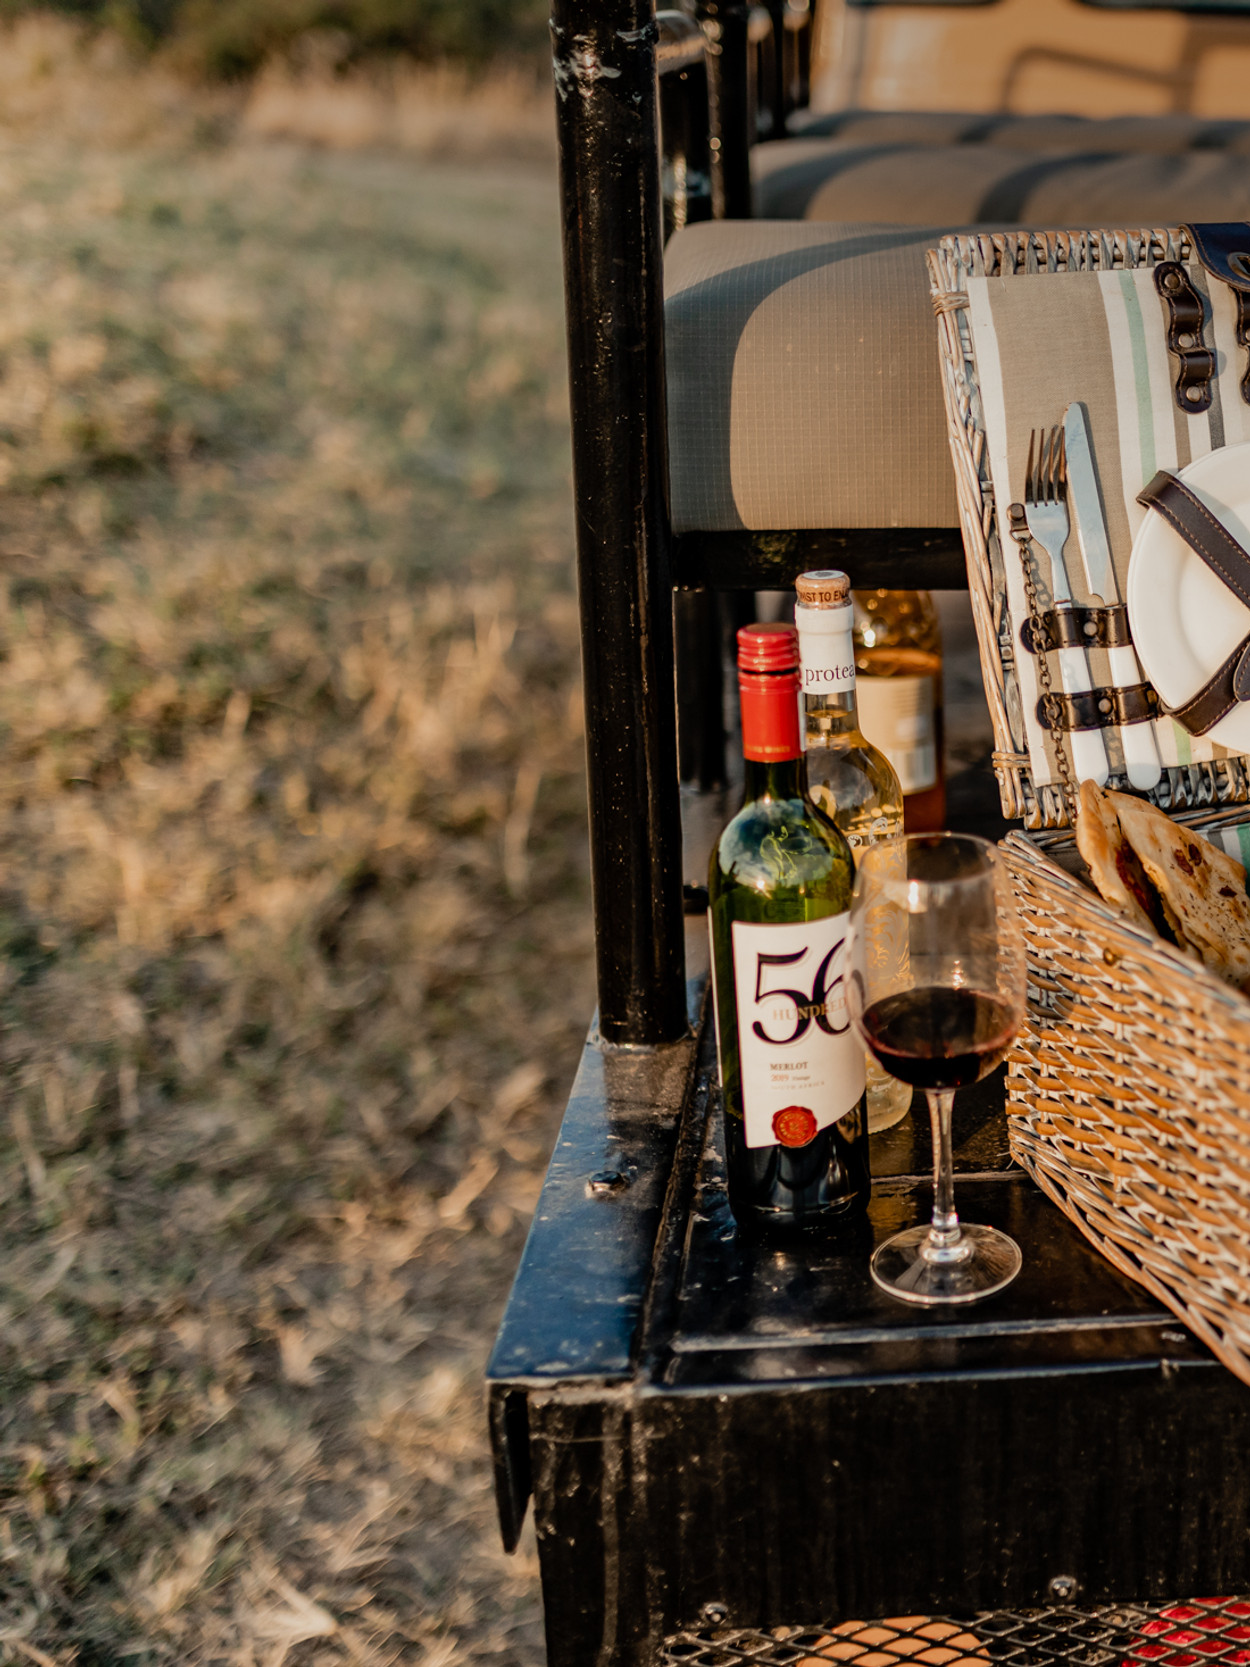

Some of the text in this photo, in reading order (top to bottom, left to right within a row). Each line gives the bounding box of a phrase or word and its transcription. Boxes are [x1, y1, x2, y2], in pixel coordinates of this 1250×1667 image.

[818, 591, 832, 603] TO
[805, 664, 855, 686] protea
[751, 936, 862, 1046] 56
[769, 1061, 809, 1071] MERLOT
